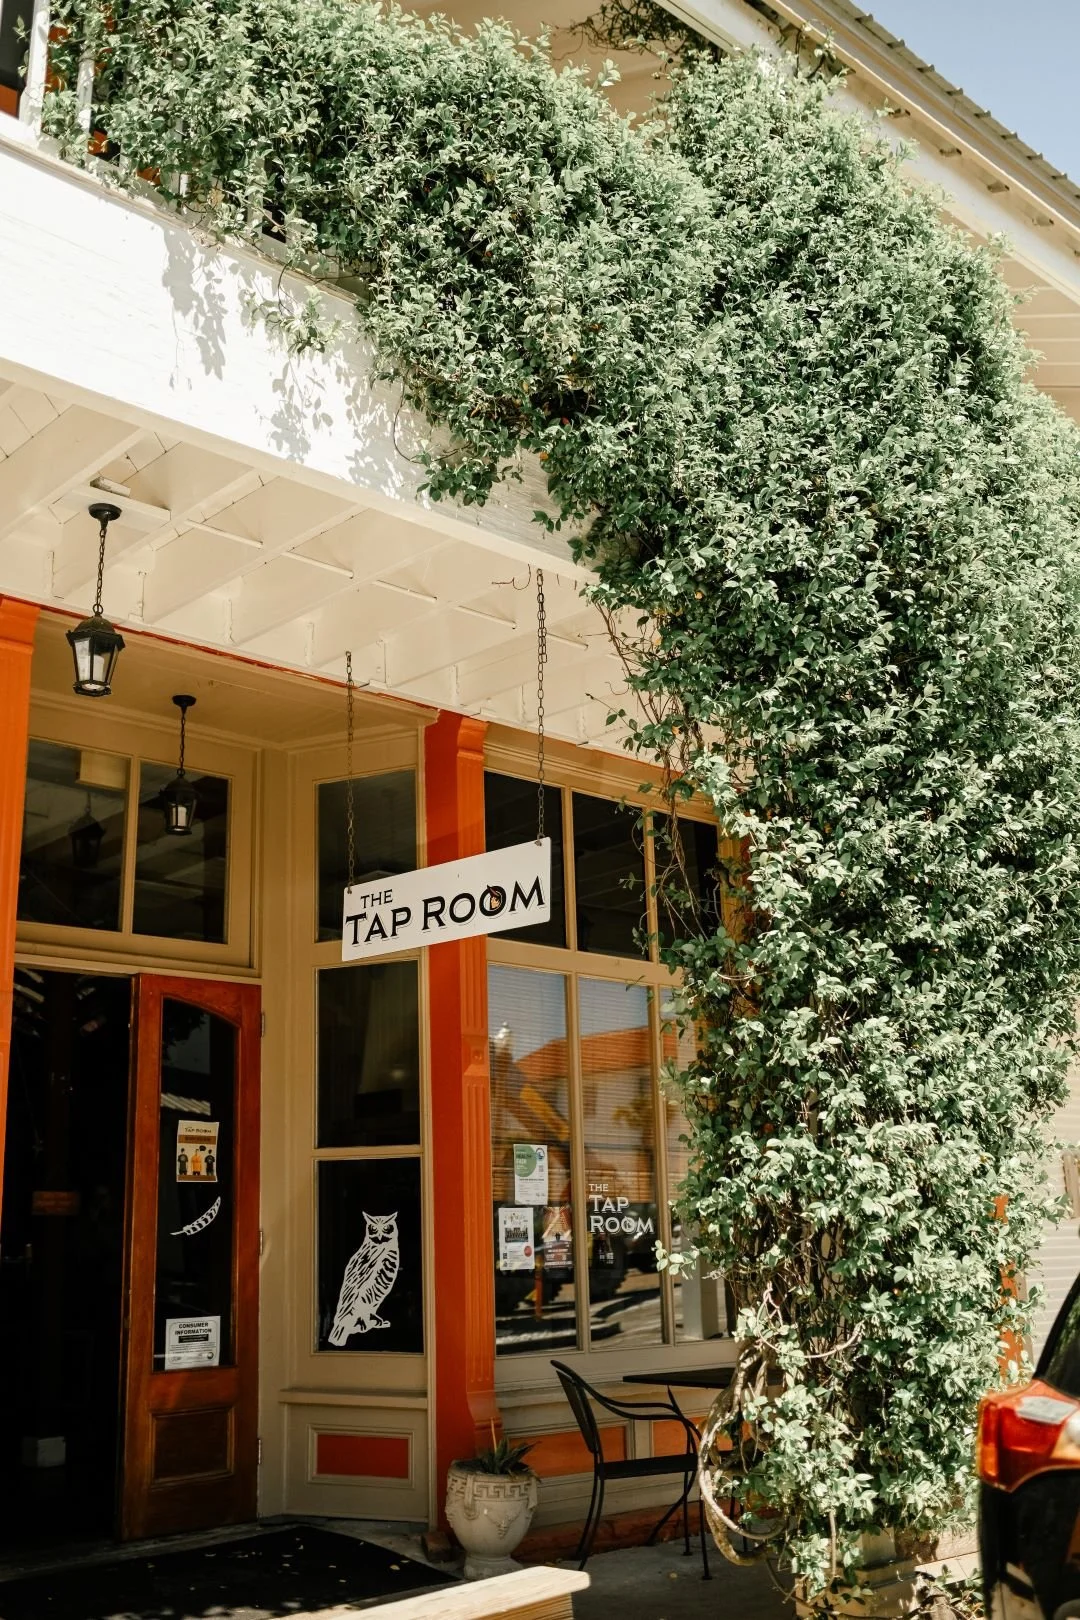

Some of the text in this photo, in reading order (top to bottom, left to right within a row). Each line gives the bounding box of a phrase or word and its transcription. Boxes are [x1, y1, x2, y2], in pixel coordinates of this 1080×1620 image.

[360, 889, 393, 909] THE
[345, 876, 545, 945] TAP ROOM
[589, 1183, 609, 1191] THE
[589, 1194, 629, 1213] TAP
[590, 1215, 654, 1233] ROOM
